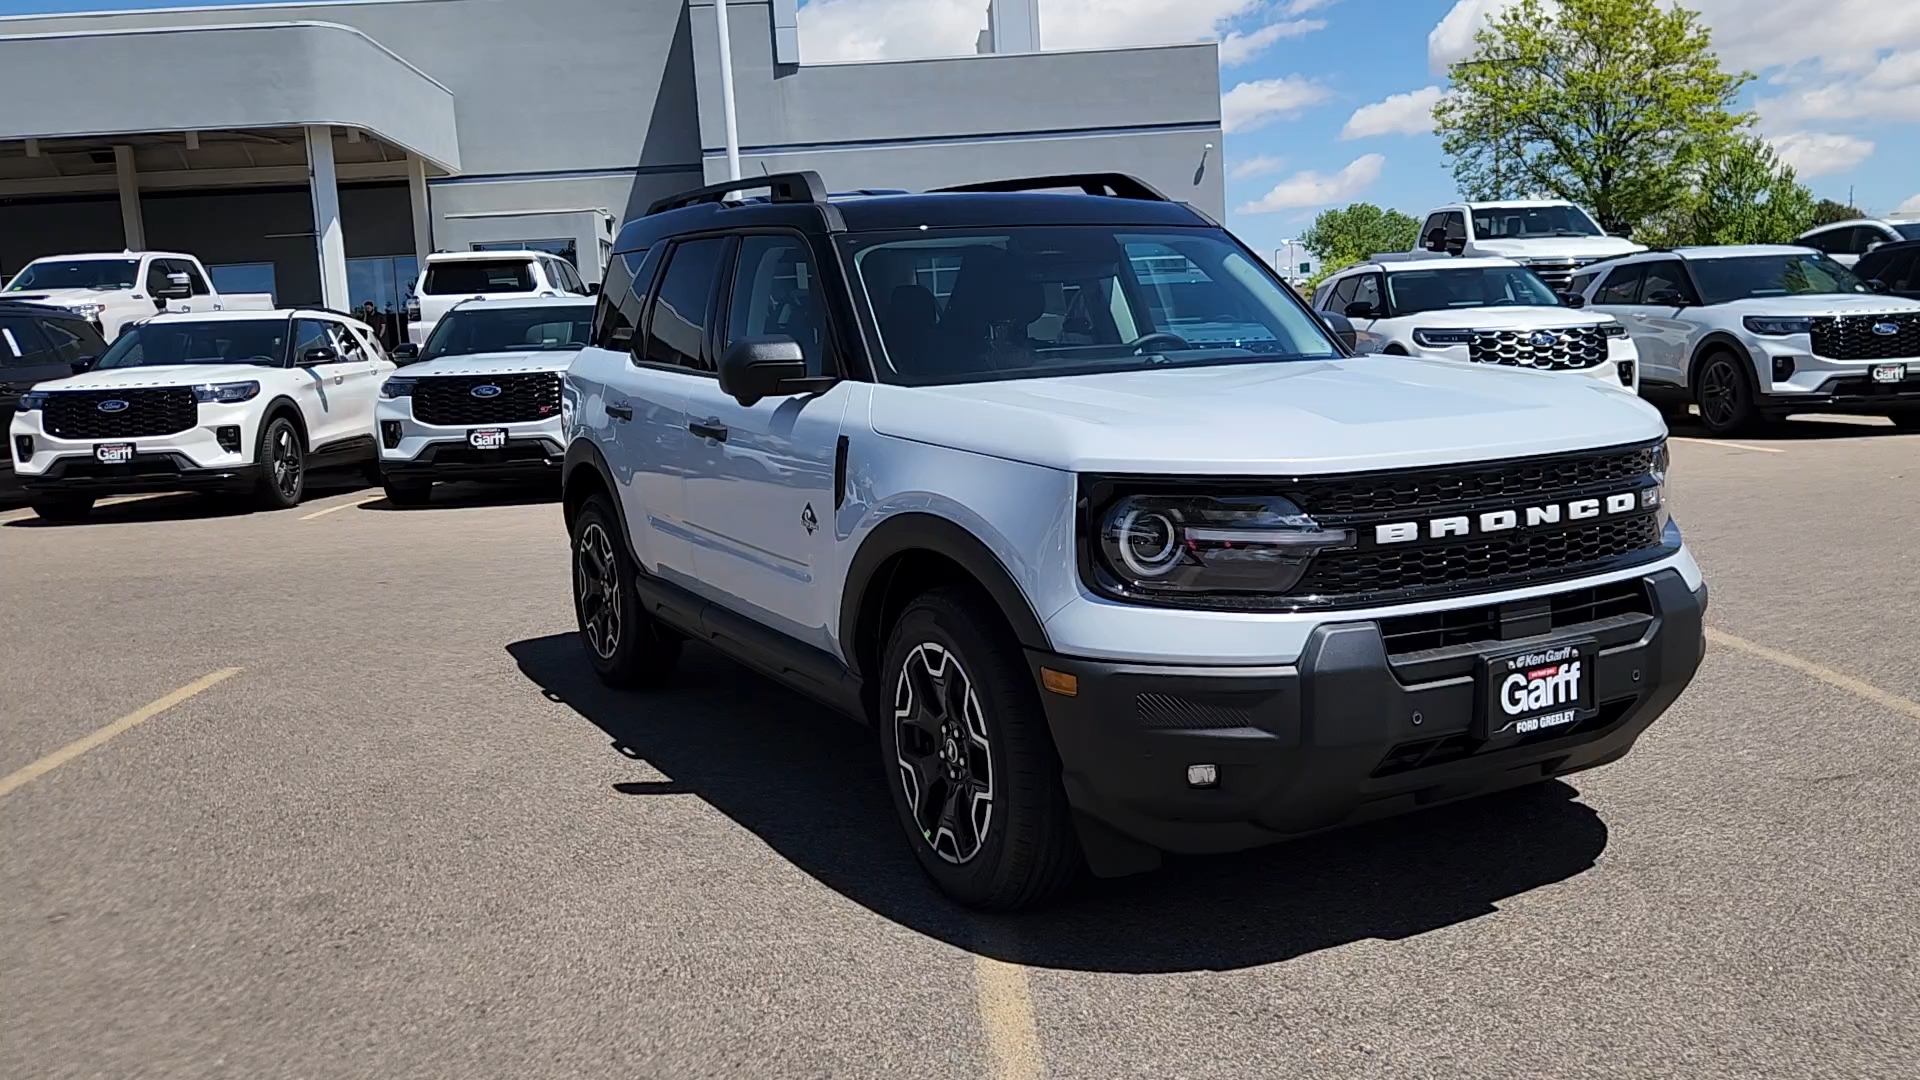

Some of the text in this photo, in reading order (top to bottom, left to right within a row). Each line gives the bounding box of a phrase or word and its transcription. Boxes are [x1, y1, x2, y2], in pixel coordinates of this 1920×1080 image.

[470, 432, 506, 446] Garff
[97, 446, 133, 460] Garff
[1375, 493, 1636, 545] BRONCO
[1525, 647, 1571, 667] Ken Garff
[1501, 661, 1581, 715] Garff
[1516, 710, 1575, 734] FORD GREELEY
